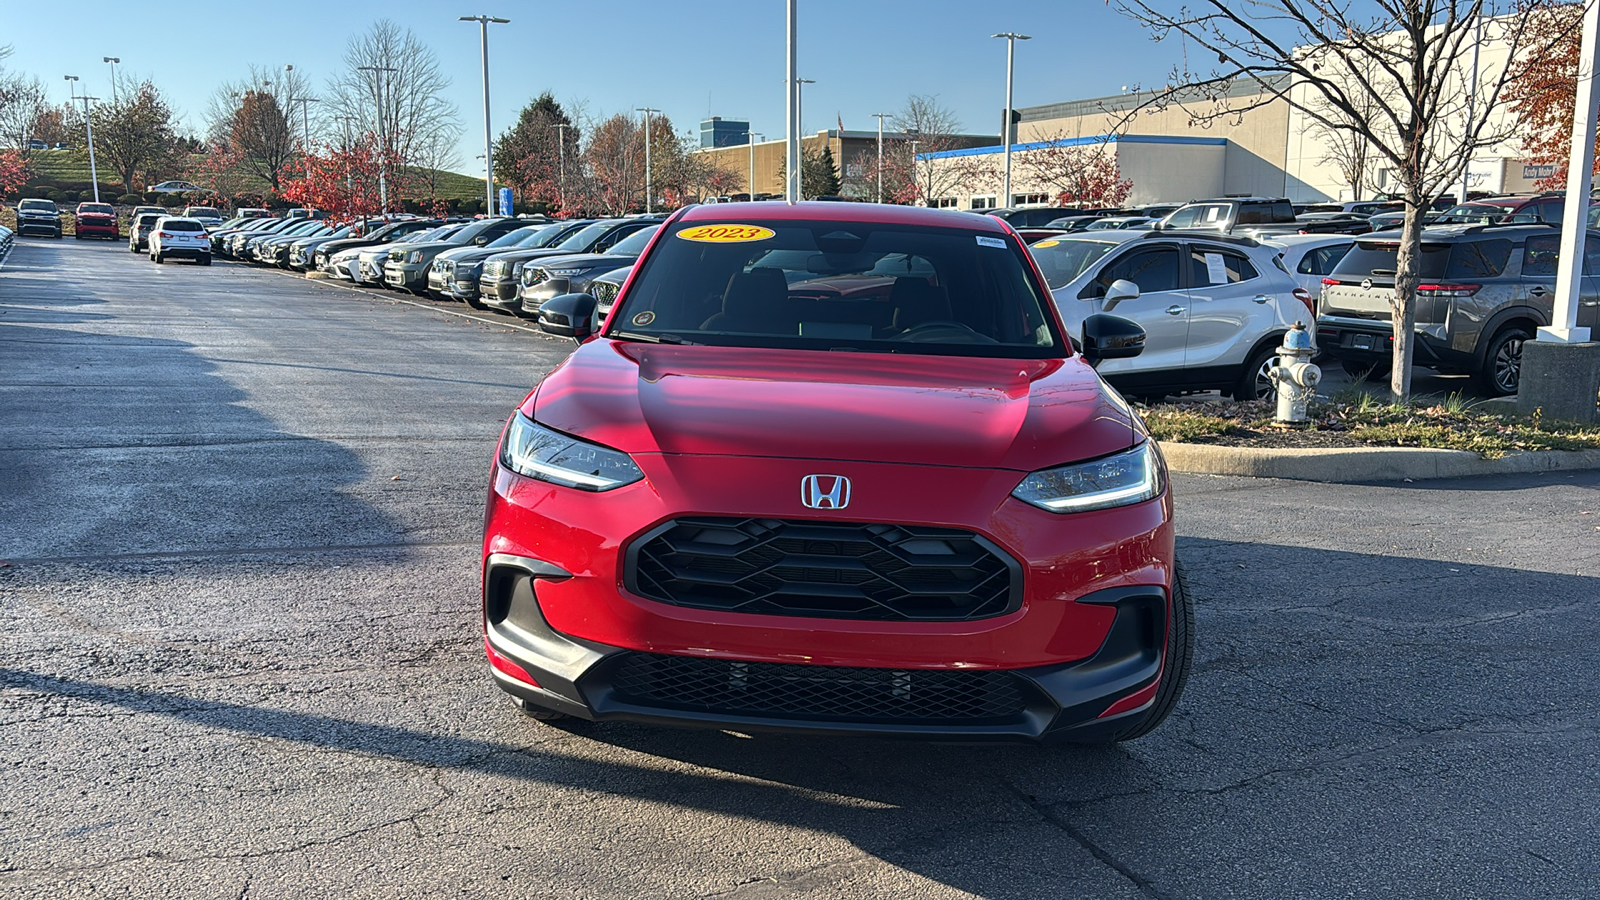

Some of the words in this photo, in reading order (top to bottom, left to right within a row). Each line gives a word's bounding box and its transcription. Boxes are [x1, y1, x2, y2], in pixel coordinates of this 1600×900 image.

[1524, 167, 1537, 178] Andy
[1538, 167, 1553, 177] Mohr
[691, 227, 760, 239] 2023
